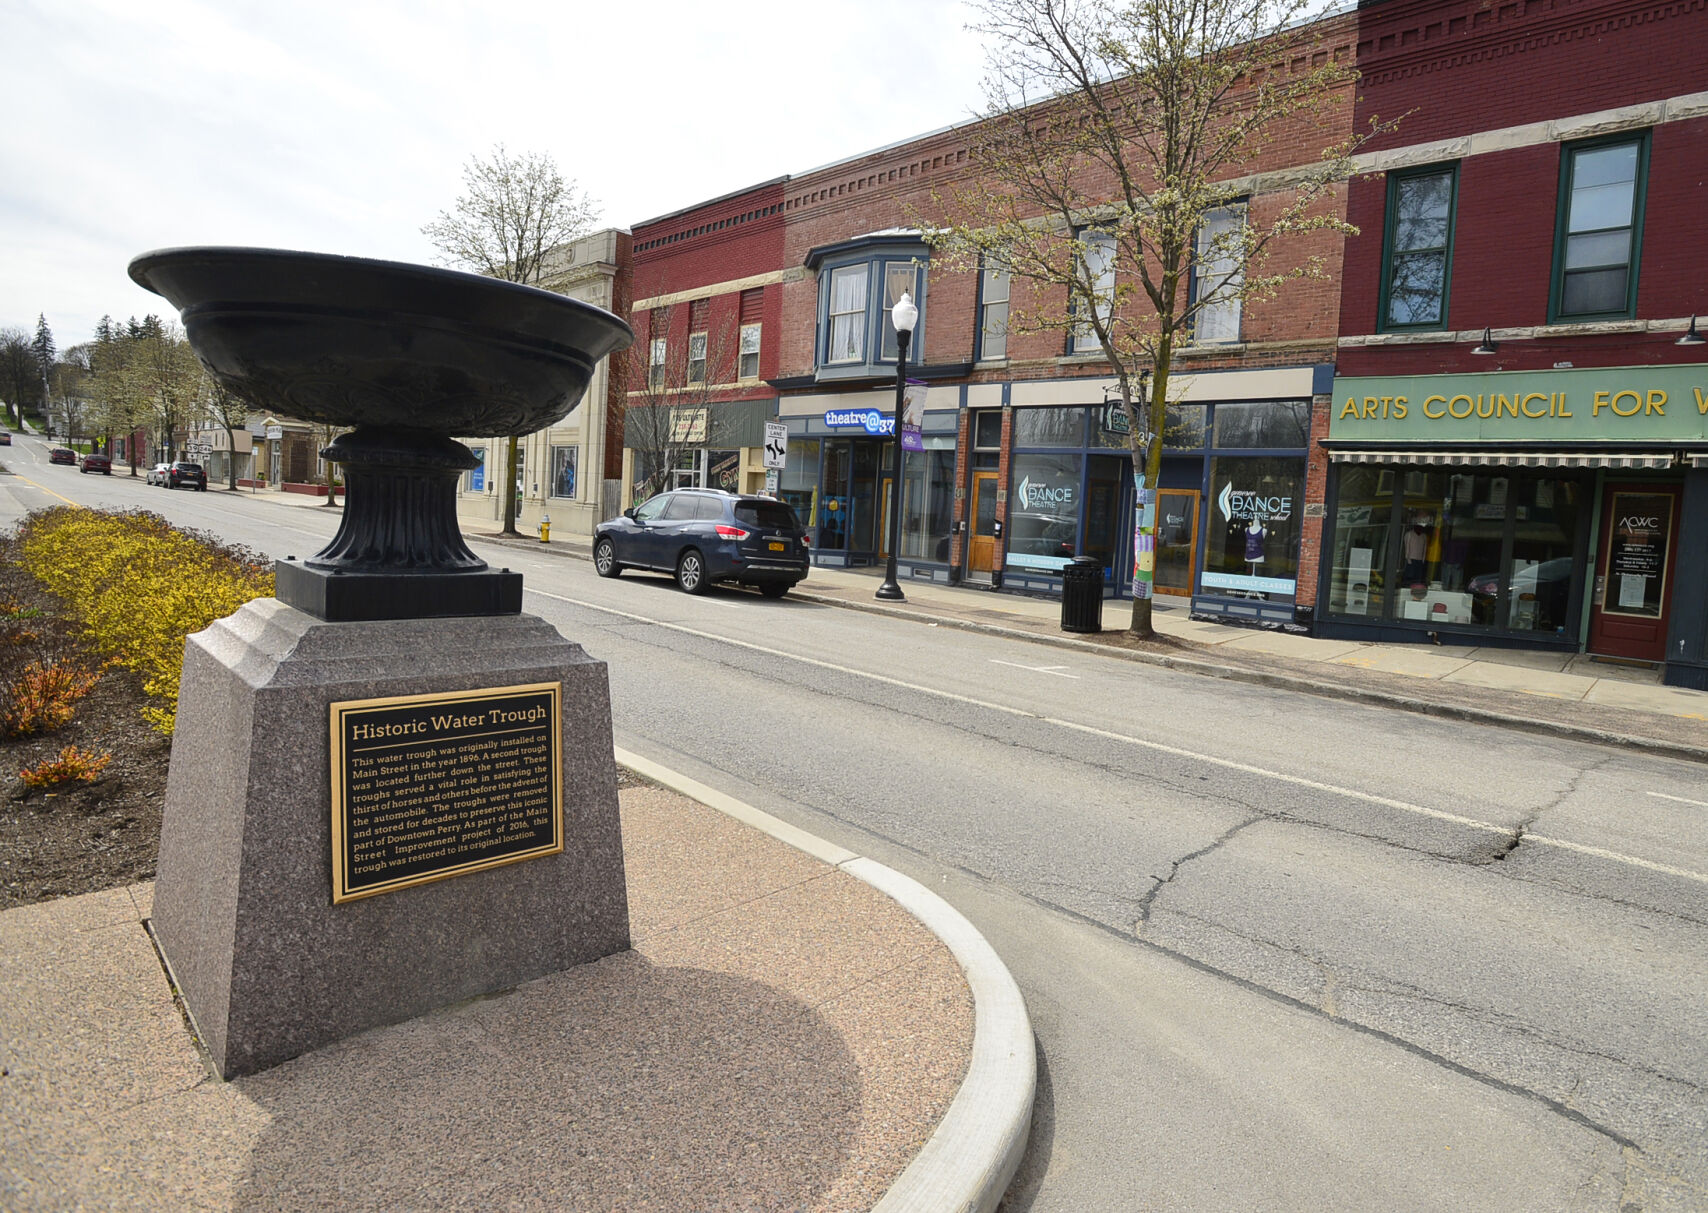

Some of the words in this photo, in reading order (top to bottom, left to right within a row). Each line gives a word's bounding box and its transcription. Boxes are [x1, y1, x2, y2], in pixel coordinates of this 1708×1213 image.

[1339, 396, 1408, 420] ARTS
[1423, 392, 1573, 419] COUNCIL
[1592, 389, 1668, 417] FOR
[768, 424, 786, 432] CENTER
[902, 424, 920, 433] ULTURE
[1028, 487, 1073, 502] DANCE
[1028, 500, 1057, 509] THEATRE
[1231, 496, 1292, 513] DANCE
[1231, 511, 1270, 521] THEATRE
[1235, 579, 1257, 587] ADULT
[1260, 581, 1293, 591] CLASSES
[353, 719, 427, 741] Historic
[430, 715, 486, 731] Water
[489, 705, 546, 724] Trough
[352, 758, 374, 767] This
[377, 755, 403, 764] water
[406, 749, 437, 760] trough
[459, 741, 498, 753] originally
[501, 736, 535, 747] installed
[353, 770, 378, 779] Main
[381, 765, 409, 775] Street
[411, 763, 420, 771] in
[422, 761, 436, 769] the
[438, 759, 458, 769] year
[460, 754, 481, 764] 1896.
[482, 752, 490, 760] A
[491, 748, 520, 759] second
[521, 744, 547, 755] trough
[353, 783, 371, 791] was
[376, 775, 410, 788] located
[415, 771, 446, 782] further
[451, 767, 474, 776] down
[478, 764, 491, 772] the
[495, 760, 520, 769] street.
[524, 756, 547, 765] These
[353, 791, 390, 803] troughs
[395, 784, 425, 796] served
[438, 779, 457, 789] vital
[461, 776, 478, 786] role
[494, 769, 532, 780] satisfying
[353, 804, 379, 815] thirst
[381, 801, 391, 810] of
[392, 798, 423, 808] horses
[424, 793, 441, 803] and
[441, 790, 470, 800] others
[470, 785, 497, 795] before
[498, 782, 512, 790] the
[513, 778, 539, 788] advent
[540, 775, 548, 783] of
[353, 818, 369, 827] the
[374, 807, 428, 823] automobile.
[432, 804, 450, 812] The
[454, 797, 487, 809] troughs
[490, 794, 510, 802] were
[514, 785, 548, 798] removed
[353, 828, 372, 839] and
[375, 822, 404, 835] stored
[407, 821, 420, 829] for
[422, 814, 458, 826] decades
[470, 805, 506, 819] preserve
[508, 802, 523, 810] this
[525, 797, 548, 807] iconic
[354, 841, 374, 853] part
[376, 837, 385, 846] of
[387, 830, 435, 844] Downtown
[437, 825, 462, 834] Perry.
[464, 821, 476, 829] As
[478, 817, 496, 828] part
[499, 813, 508, 822] of
[510, 812, 524, 820] the
[526, 808, 548, 817] Main
[354, 850, 386, 863] Street
[395, 836, 456, 854] Improvement
[462, 829, 491, 843] project
[496, 825, 505, 833] of
[510, 821, 529, 831] 2016,
[534, 818, 548, 826] this
[354, 861, 387, 874] trough
[389, 858, 407, 867] was
[409, 848, 446, 863] restored
[470, 836, 502, 850] original
[503, 831, 536, 843] location.
